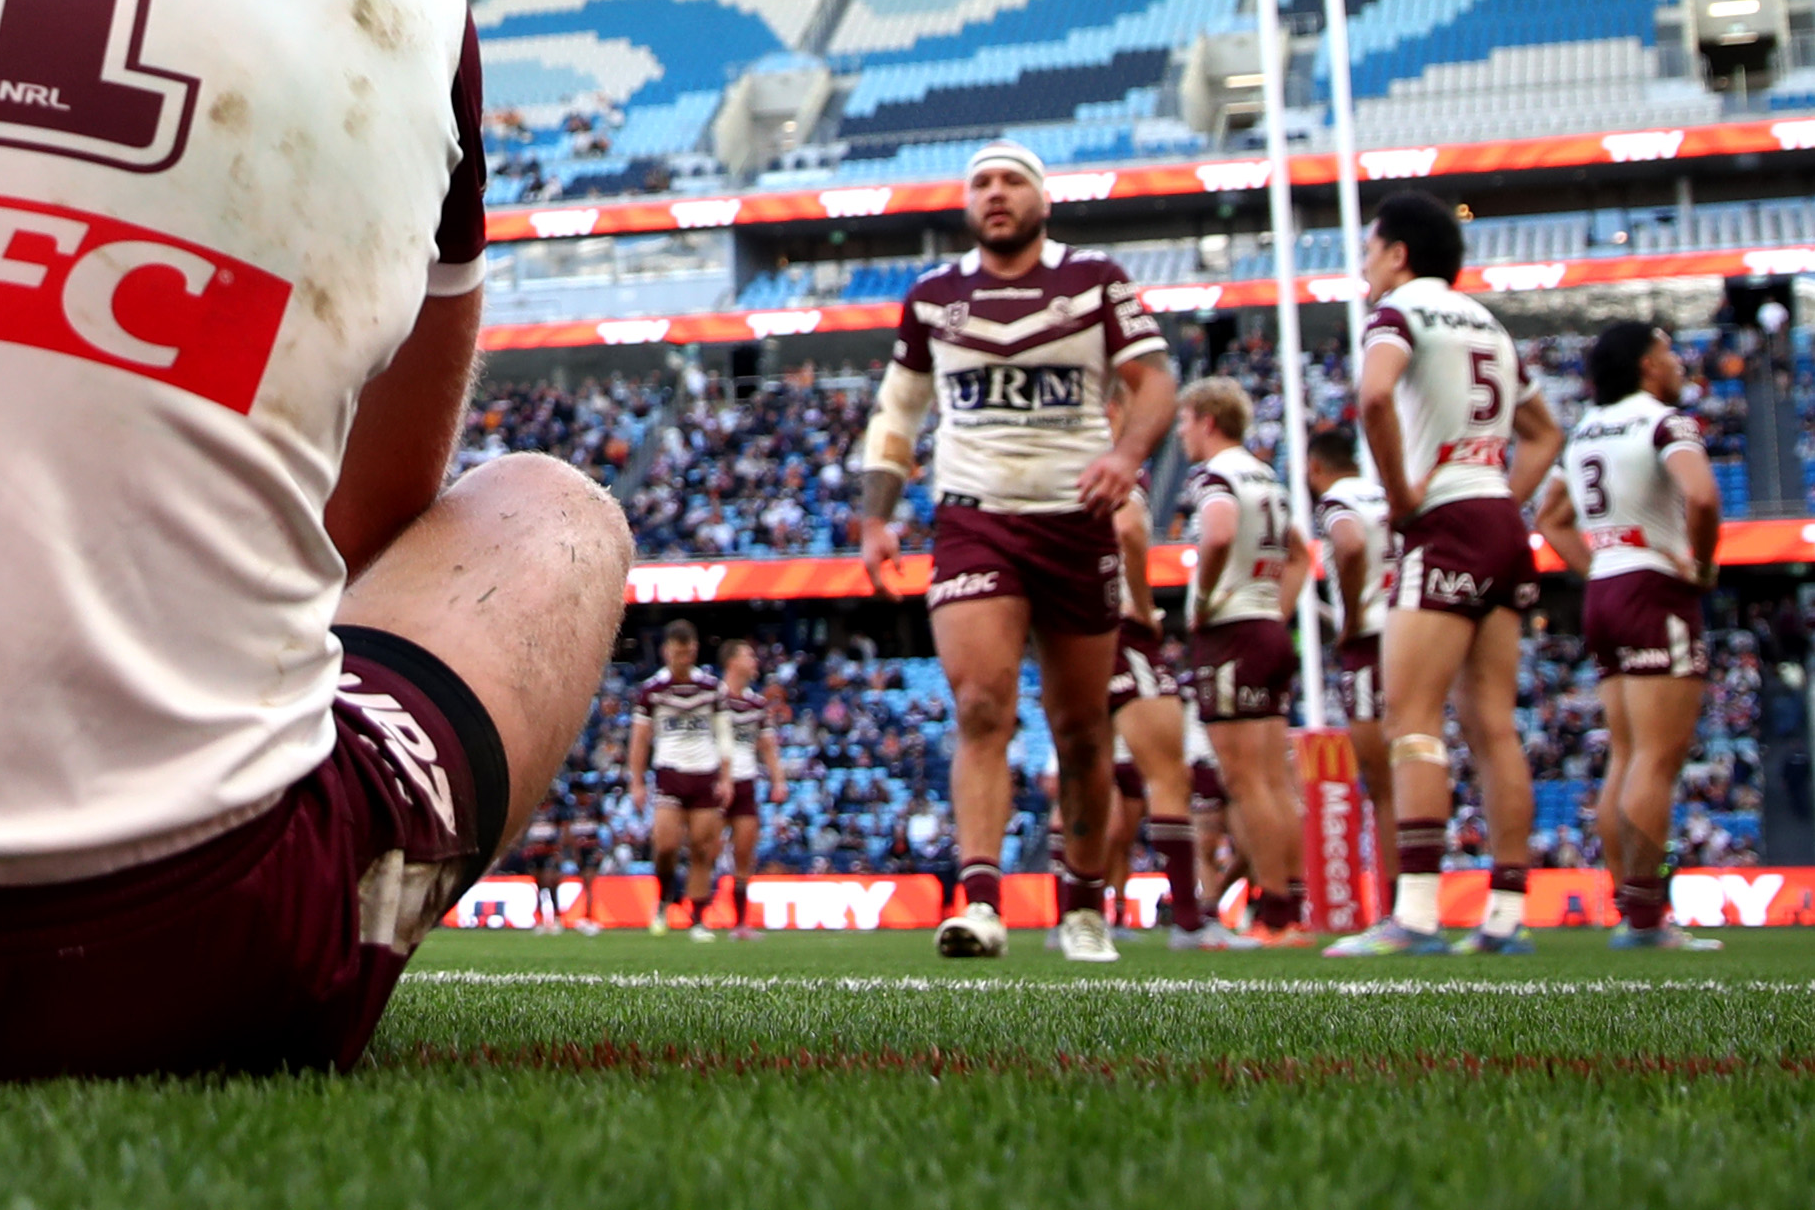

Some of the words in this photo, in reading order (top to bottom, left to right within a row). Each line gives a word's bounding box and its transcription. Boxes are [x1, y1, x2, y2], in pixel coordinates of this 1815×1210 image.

[950, 367, 1083, 410] URM
[1469, 345, 1504, 428] 5
[1580, 451, 1613, 519] 3
[626, 563, 728, 604] TRY
[1319, 780, 1359, 930] Macca's
[747, 881, 896, 931] TRY
[1670, 874, 1784, 927] RY
